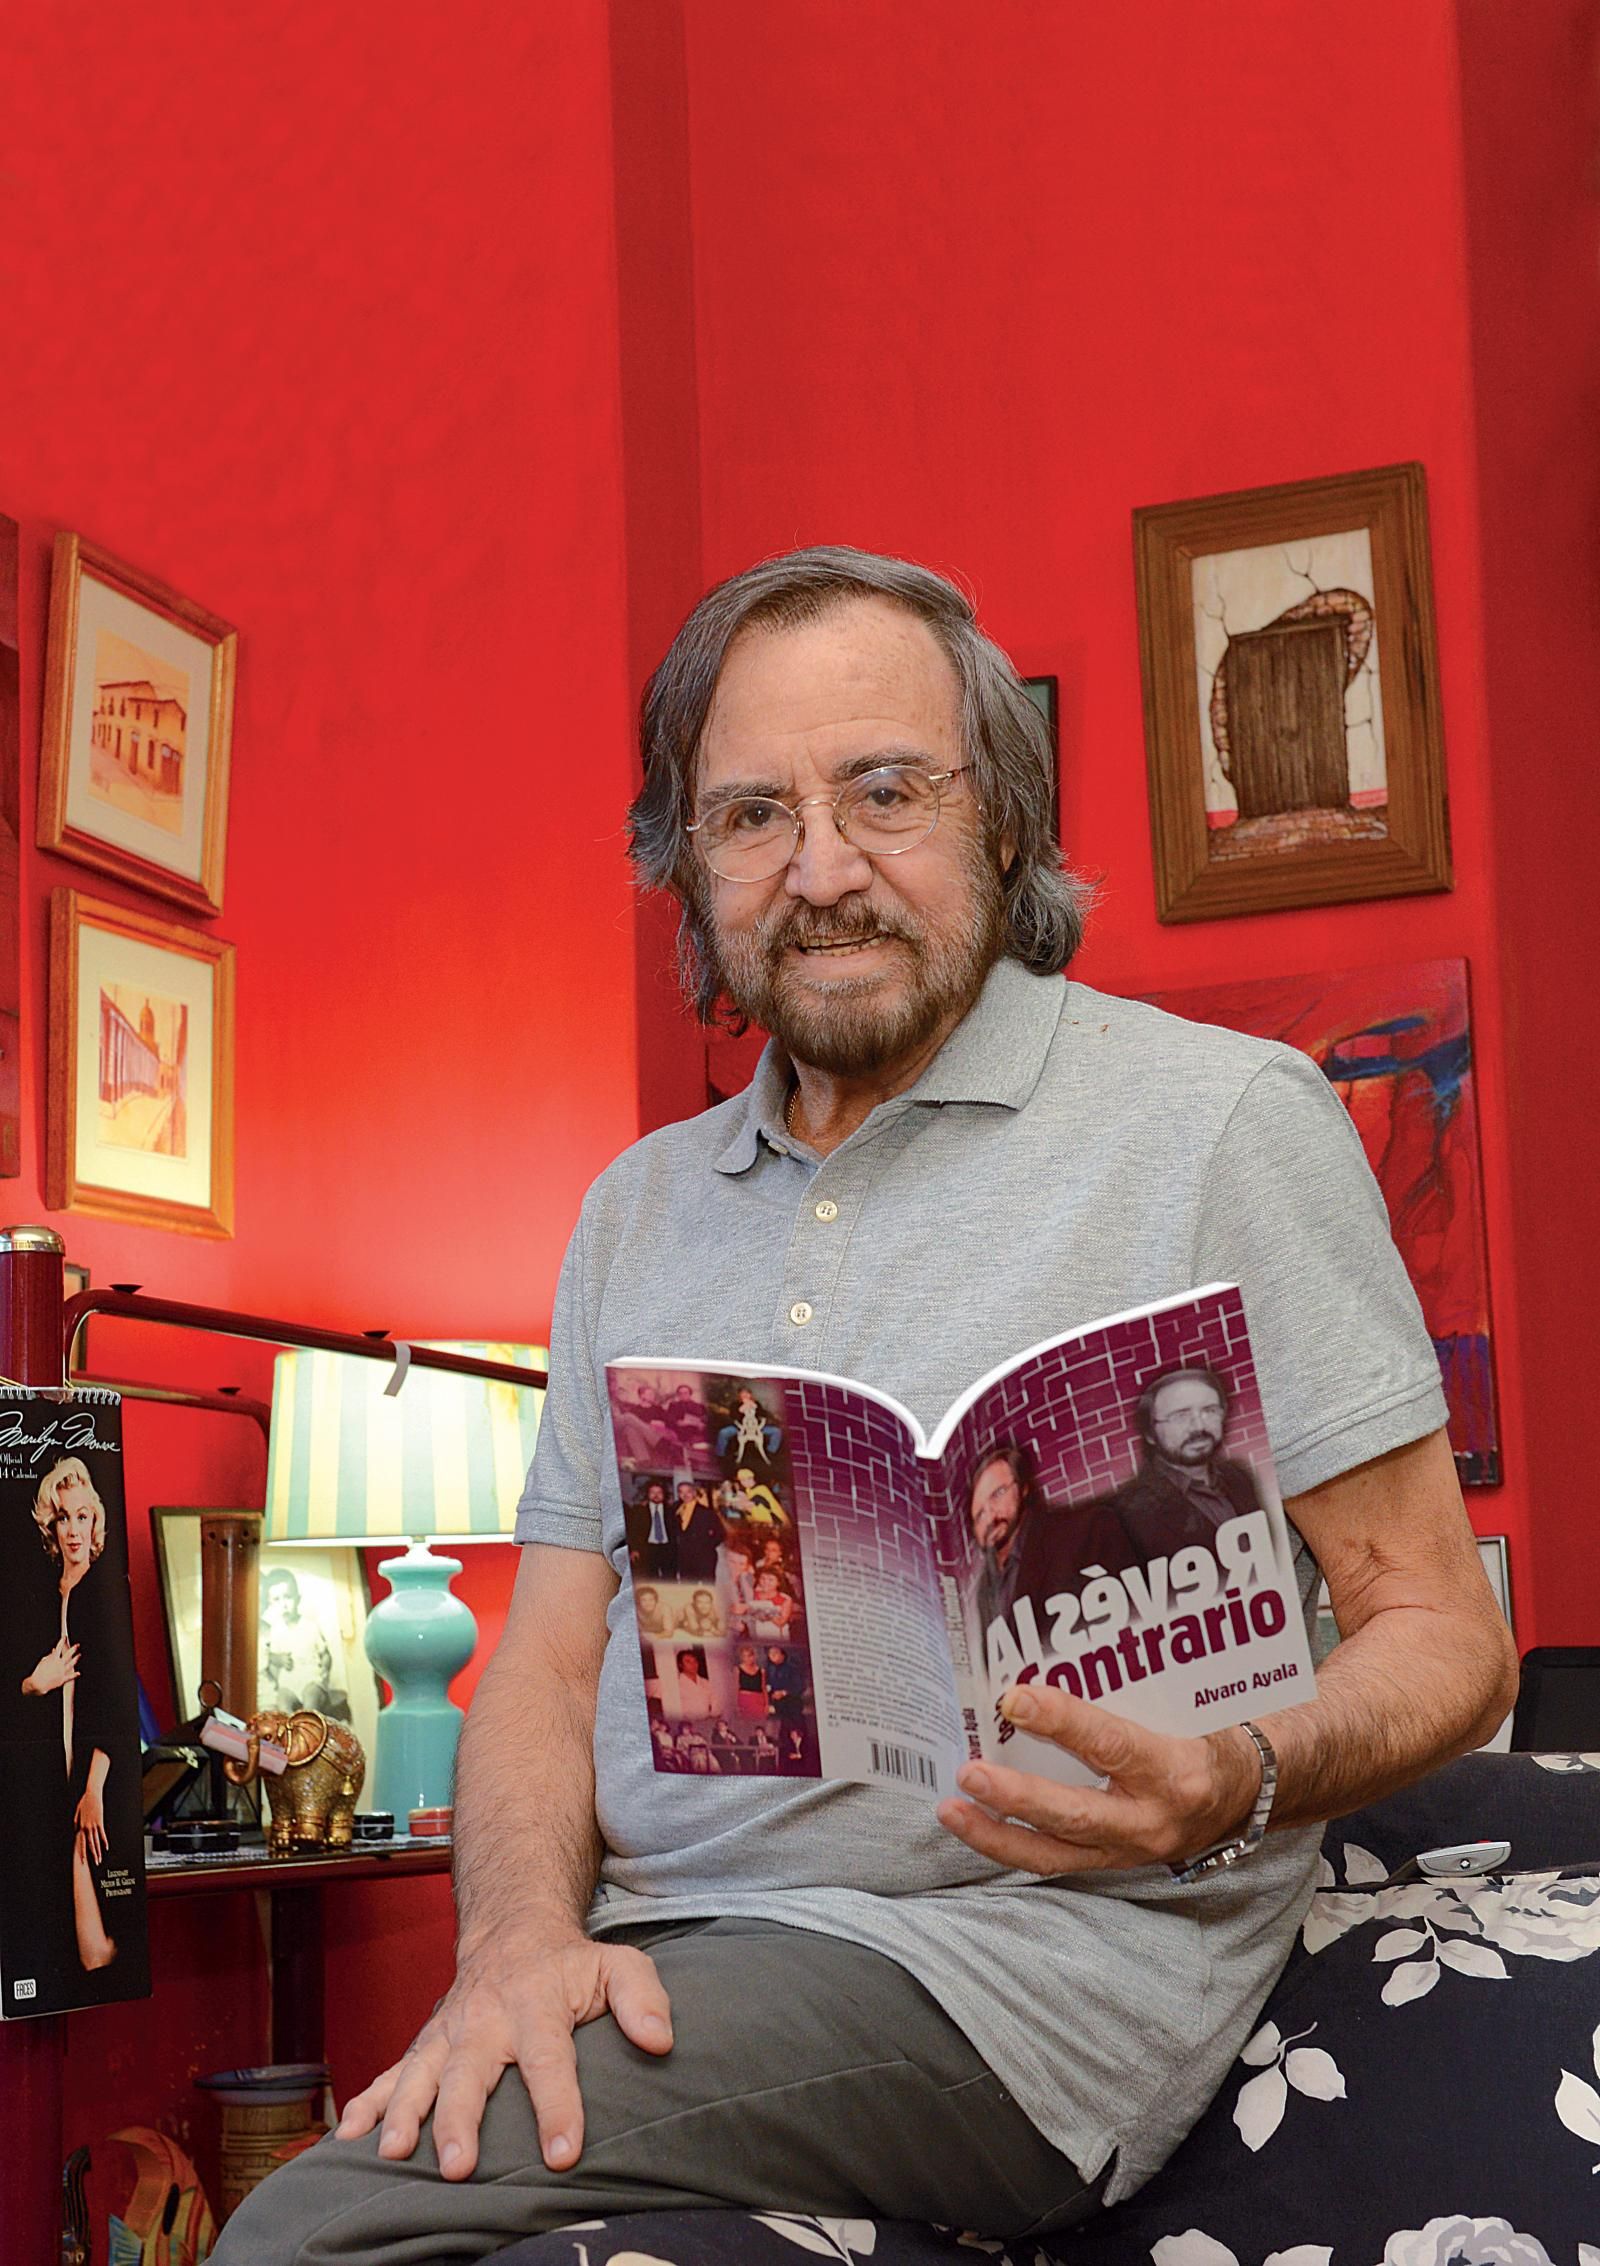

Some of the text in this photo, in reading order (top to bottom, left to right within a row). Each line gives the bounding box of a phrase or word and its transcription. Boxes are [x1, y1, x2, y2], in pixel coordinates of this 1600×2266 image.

[0, 1410, 121, 1464] Marilyn Monroe
[11, 1467, 38, 1479] Calendar
[1194, 1663, 1298, 1708] Alvaro Ayala
[16, 1982, 34, 1997] FACES
